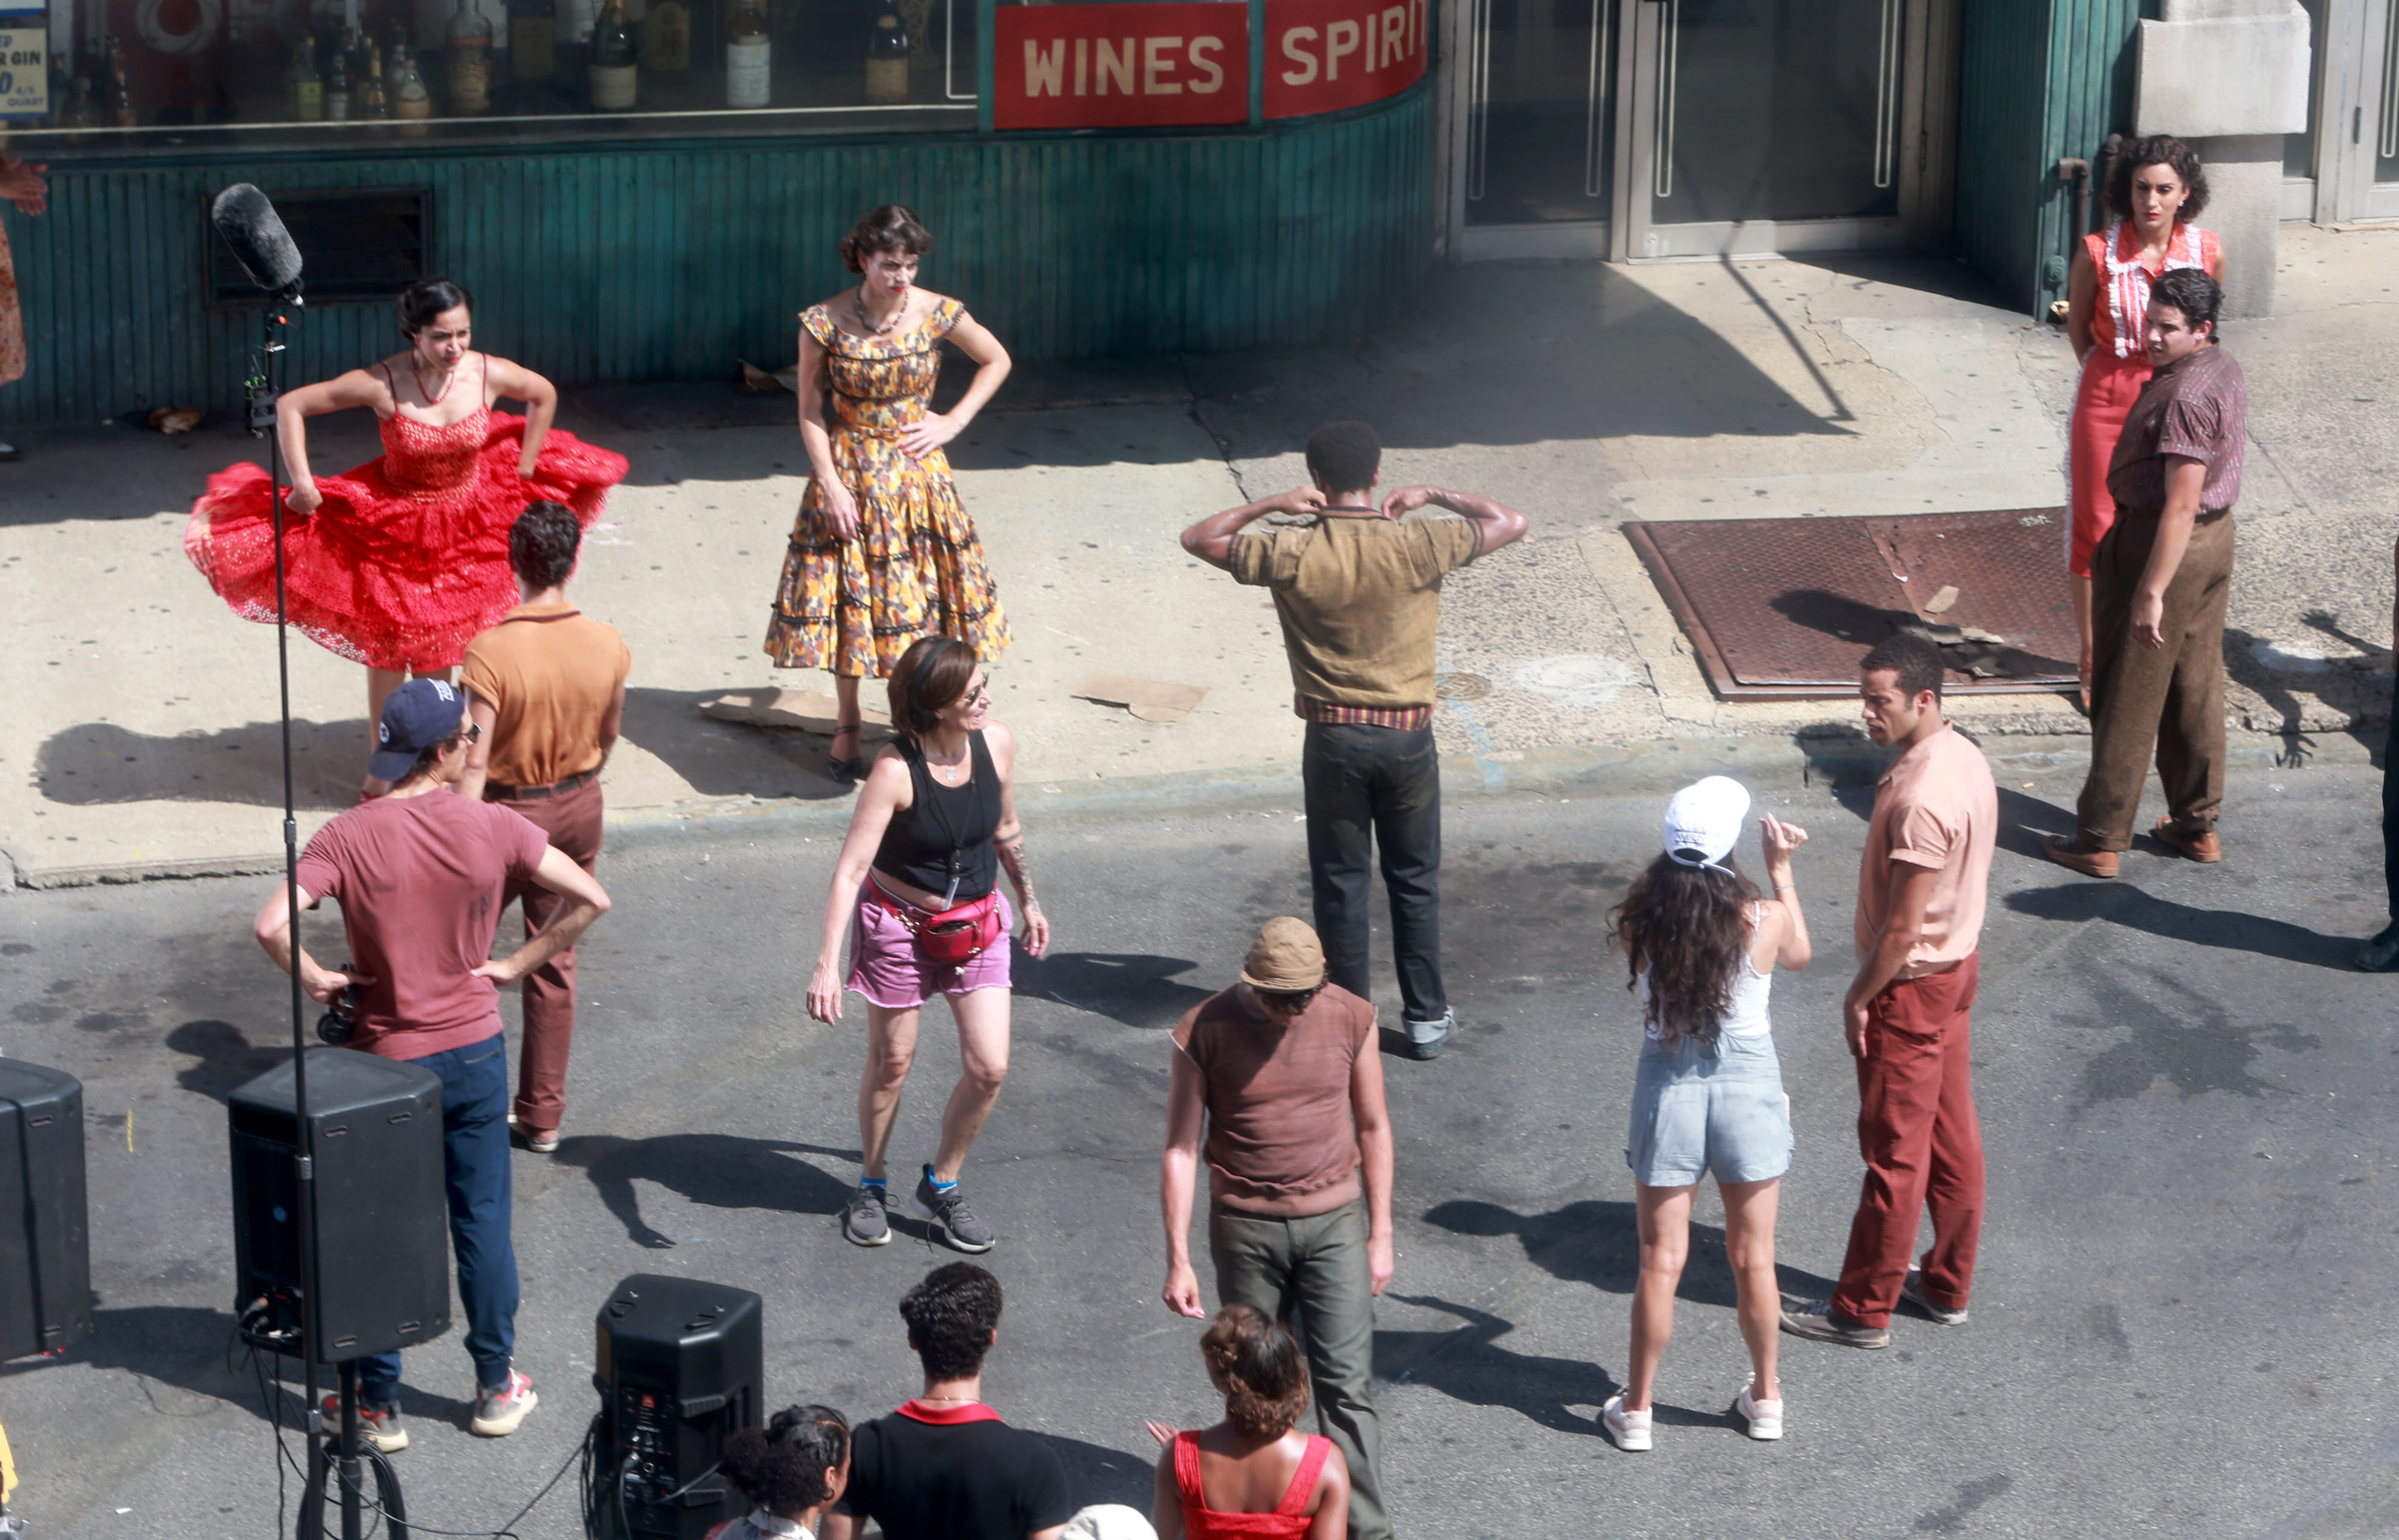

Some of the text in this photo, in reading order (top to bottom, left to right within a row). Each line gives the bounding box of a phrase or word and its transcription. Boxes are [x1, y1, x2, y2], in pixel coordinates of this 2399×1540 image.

[11, 51, 41, 66] GIN
[1023, 36, 1224, 97] WINES
[7, 97, 44, 107] QUART
